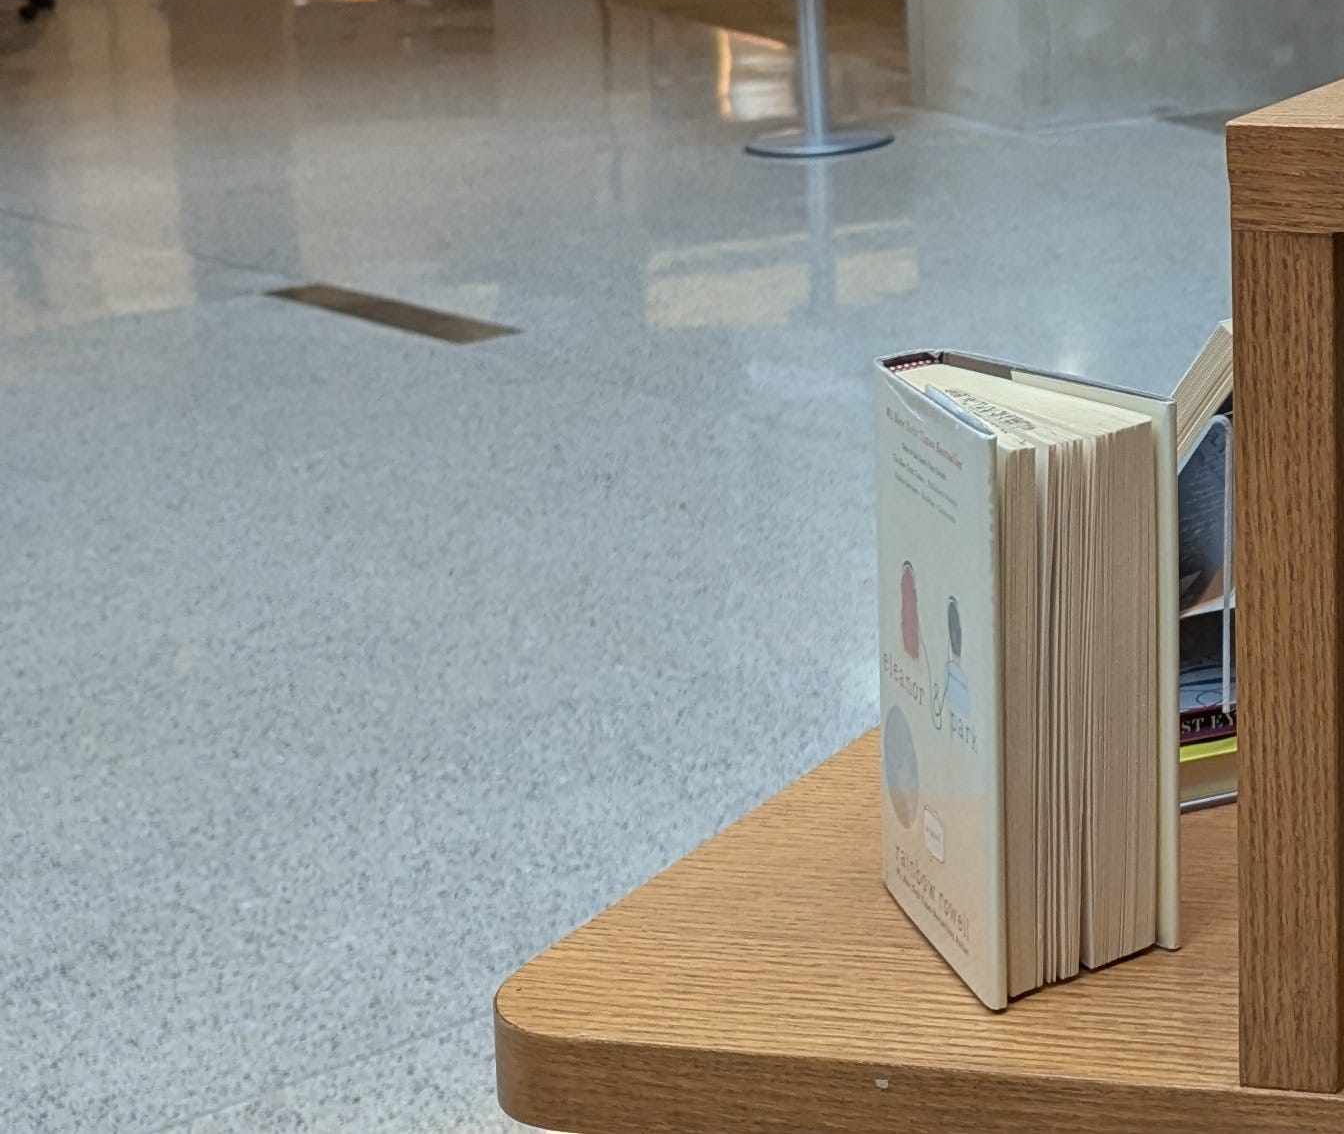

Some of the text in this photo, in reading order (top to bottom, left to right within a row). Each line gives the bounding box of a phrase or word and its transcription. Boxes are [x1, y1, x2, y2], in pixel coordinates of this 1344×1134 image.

[882, 650, 926, 707] eleanor
[950, 710, 979, 755] park
[895, 844, 937, 901] rainbow
[939, 892, 971, 943] rowell
